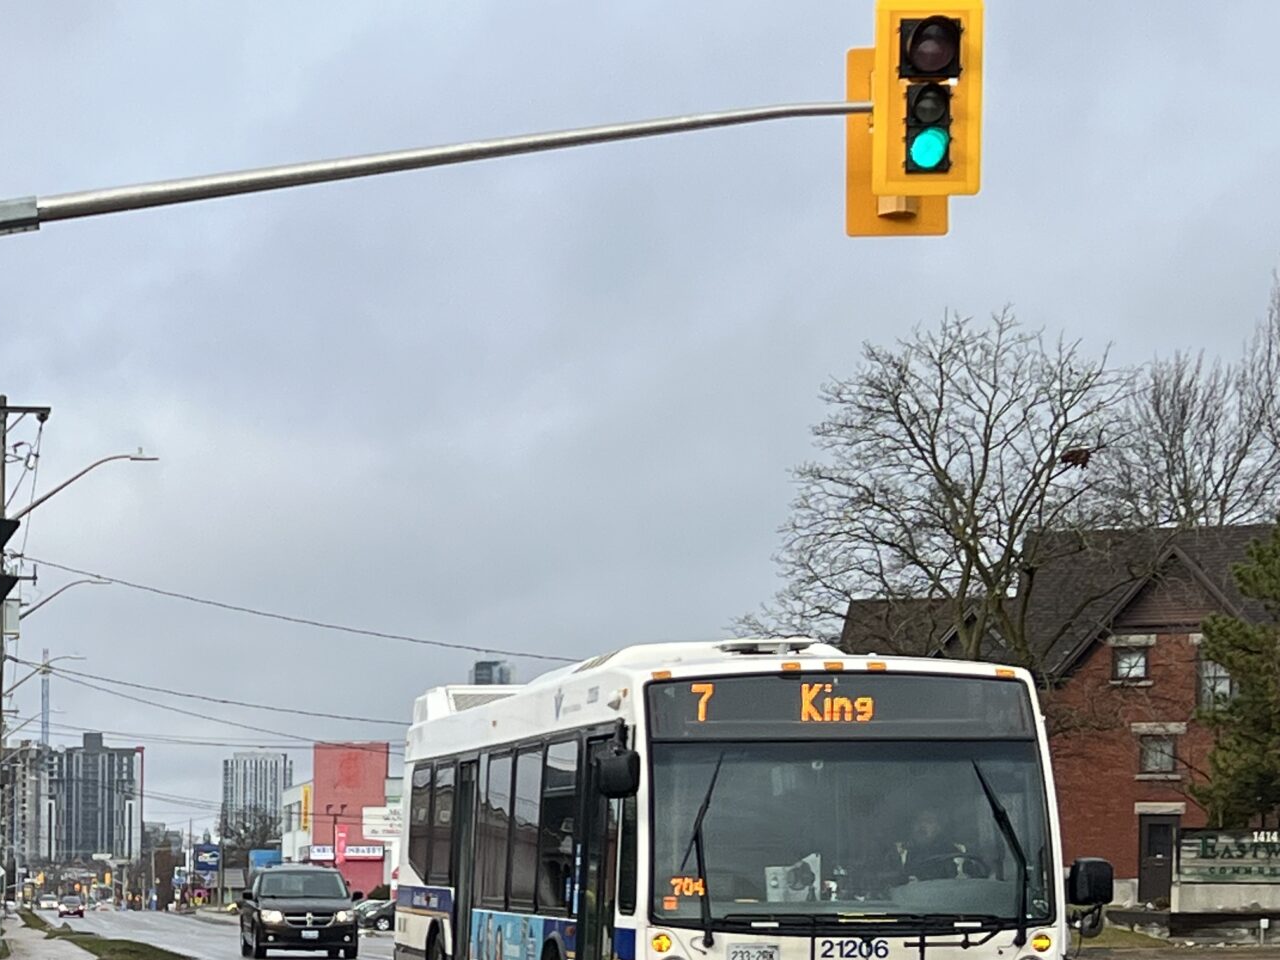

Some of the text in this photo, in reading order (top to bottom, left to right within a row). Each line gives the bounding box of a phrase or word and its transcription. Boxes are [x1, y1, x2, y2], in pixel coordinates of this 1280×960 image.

[690, 682, 874, 722] 7 King
[1252, 831, 1279, 842] 1414
[670, 877, 705, 896] 704
[821, 940, 889, 958] 21206
